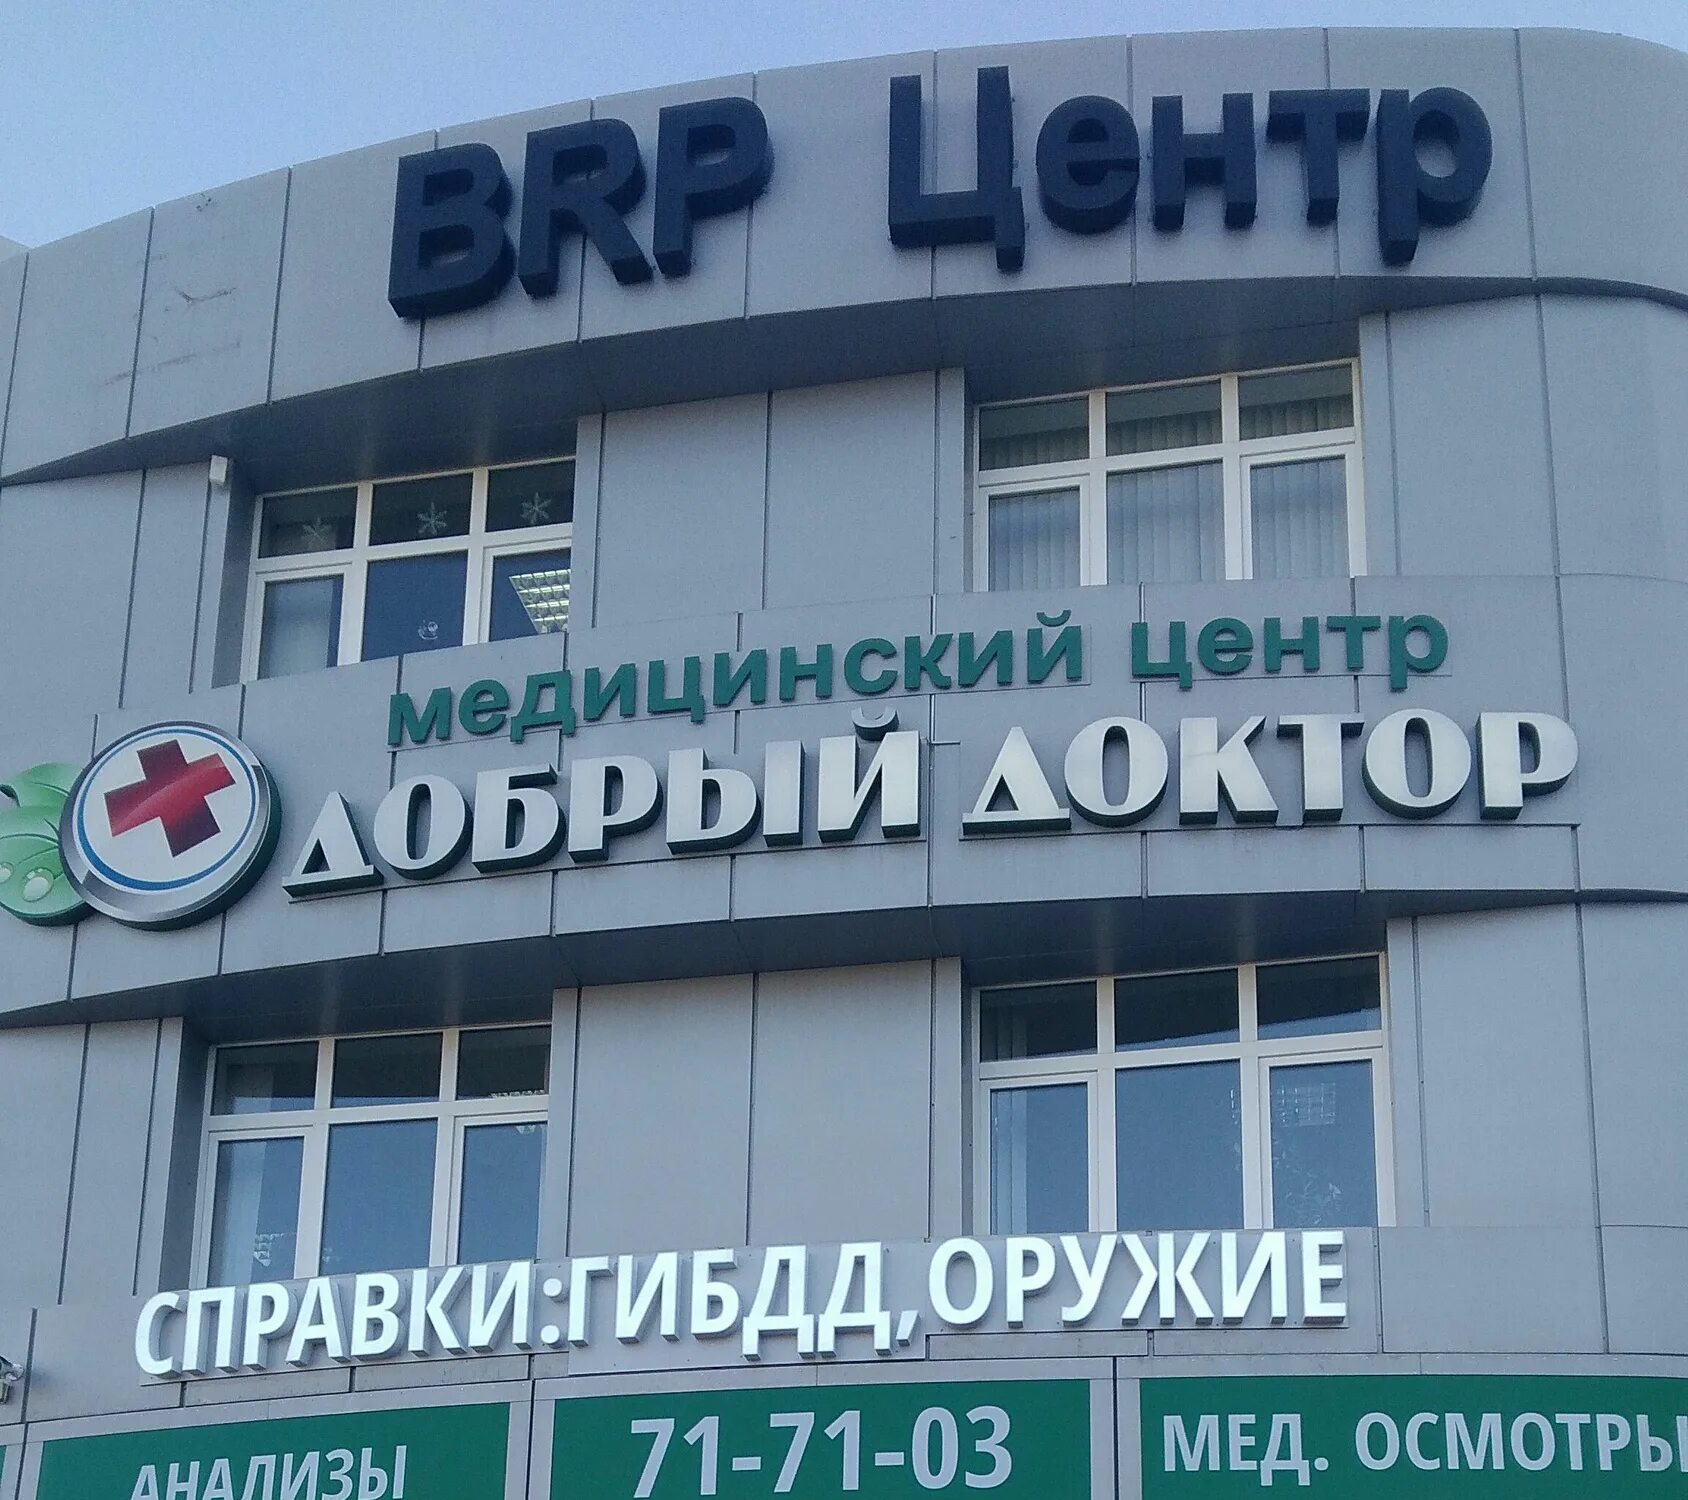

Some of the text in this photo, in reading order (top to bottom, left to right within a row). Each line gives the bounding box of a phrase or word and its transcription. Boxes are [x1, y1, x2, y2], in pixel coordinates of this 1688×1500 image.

[388, 66, 1493, 318] BRP Центр
[388, 609, 1449, 746] медицинский центр
[282, 706, 1579, 896] ДОБРЫЙ ДОКТОР
[630, 1405, 1013, 1499] 71-71-03
[1163, 1411, 1688, 1486] МЕД. ОСМОТРЫ
